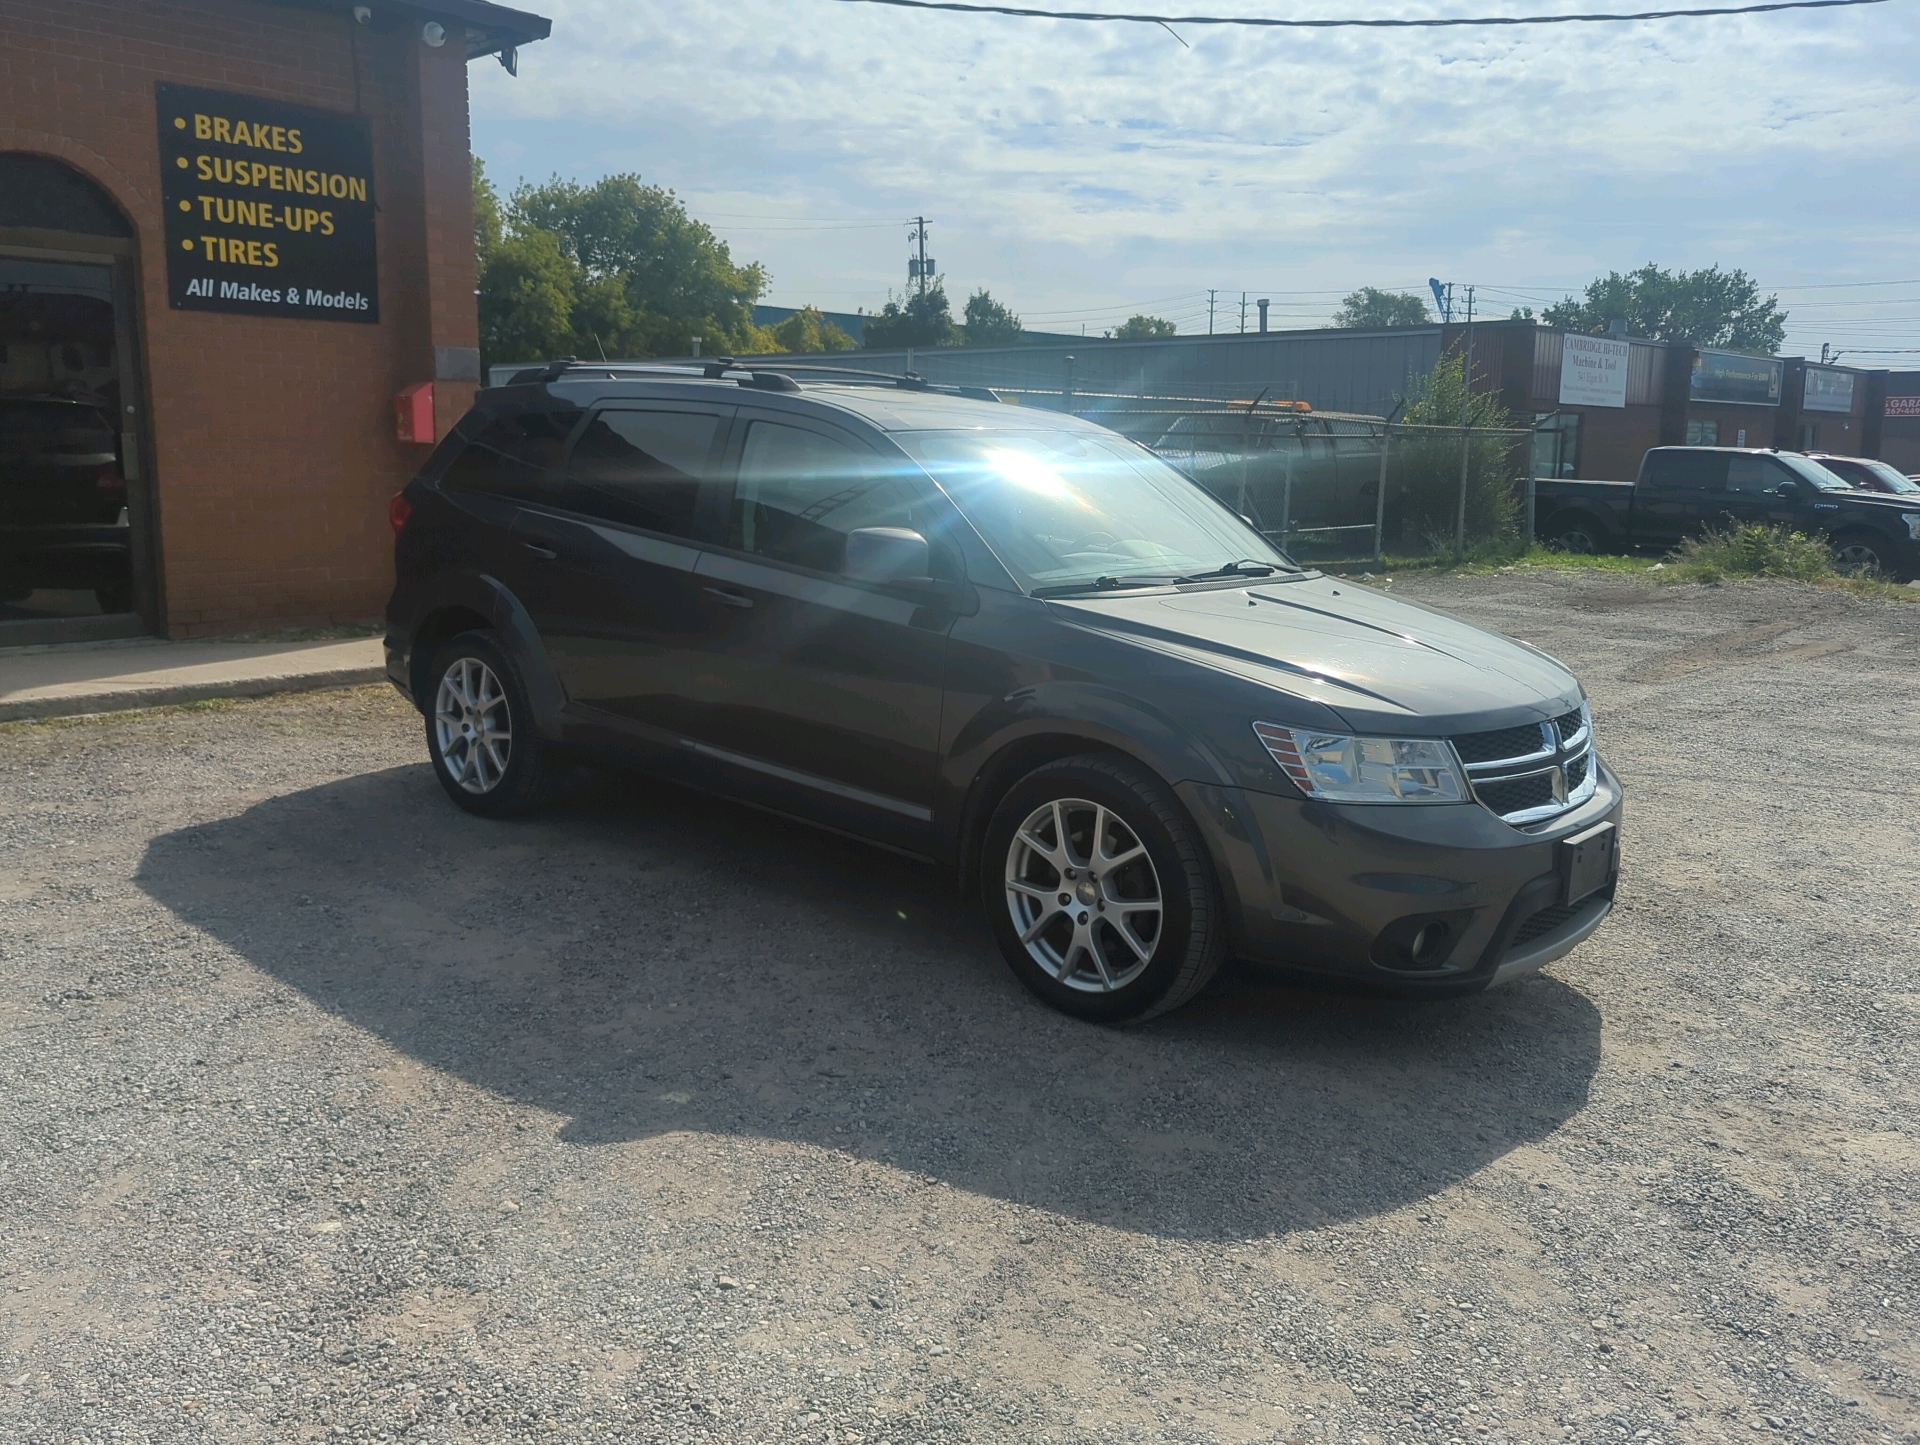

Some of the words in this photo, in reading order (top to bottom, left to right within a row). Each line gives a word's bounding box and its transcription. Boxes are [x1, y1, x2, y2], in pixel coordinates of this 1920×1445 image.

[194, 113, 303, 154] BRAKES
[196, 155, 367, 202] SUSPENSION
[198, 195, 335, 236] TUNE-UPS
[200, 236, 279, 267] TIRES
[186, 278, 213, 297] All
[220, 281, 281, 303] Makes
[286, 287, 300, 305] &
[305, 289, 369, 310] Models
[1564, 337, 1602, 354] CAMBRIDGE
[1603, 343, 1628, 357] HI-TECH
[1572, 355, 1597, 369] Machine
[1597, 358, 1603, 369] &
[1605, 358, 1617, 370] Tool
